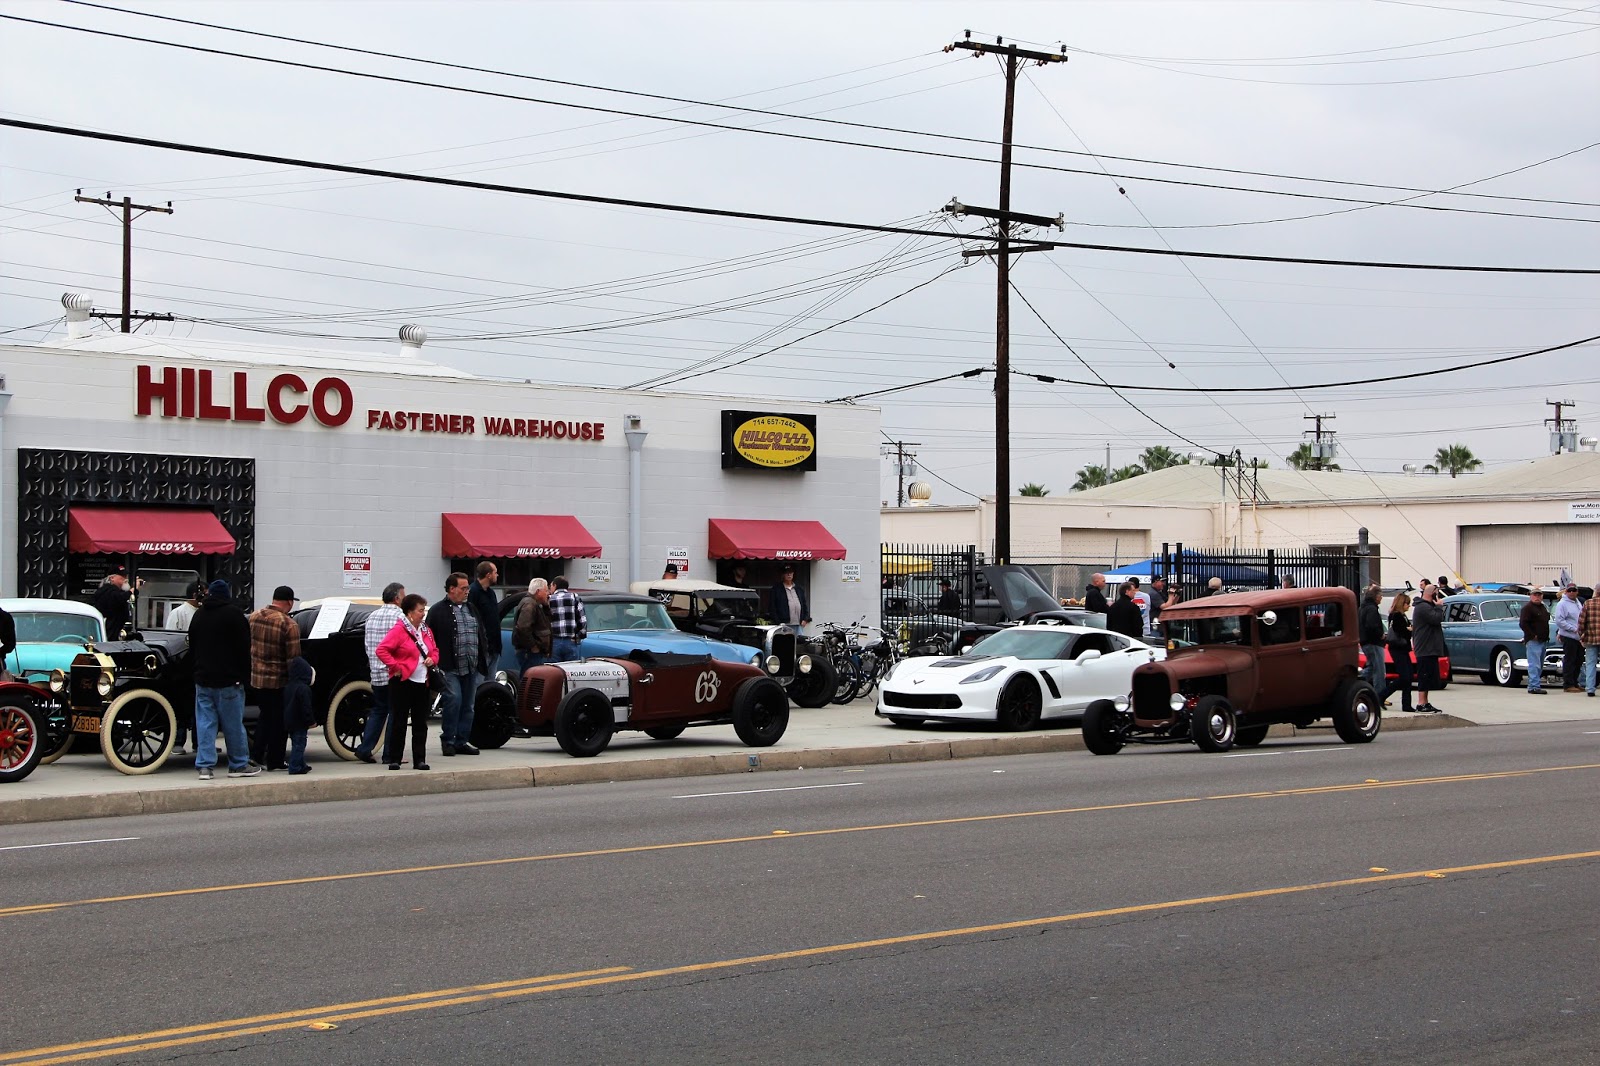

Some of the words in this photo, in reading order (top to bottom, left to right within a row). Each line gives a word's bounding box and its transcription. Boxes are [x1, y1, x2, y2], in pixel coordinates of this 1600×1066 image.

[136, 365, 353, 427] HILLCO
[367, 409, 475, 433] FASTENER
[484, 416, 605, 441] WAREHOUSE
[741, 430, 783, 443] HILLCO
[738, 441, 771, 450] Fastener
[772, 442, 811, 452] Warehouse
[138, 543, 173, 551] HILLCO
[517, 548, 544, 556] HILLCO
